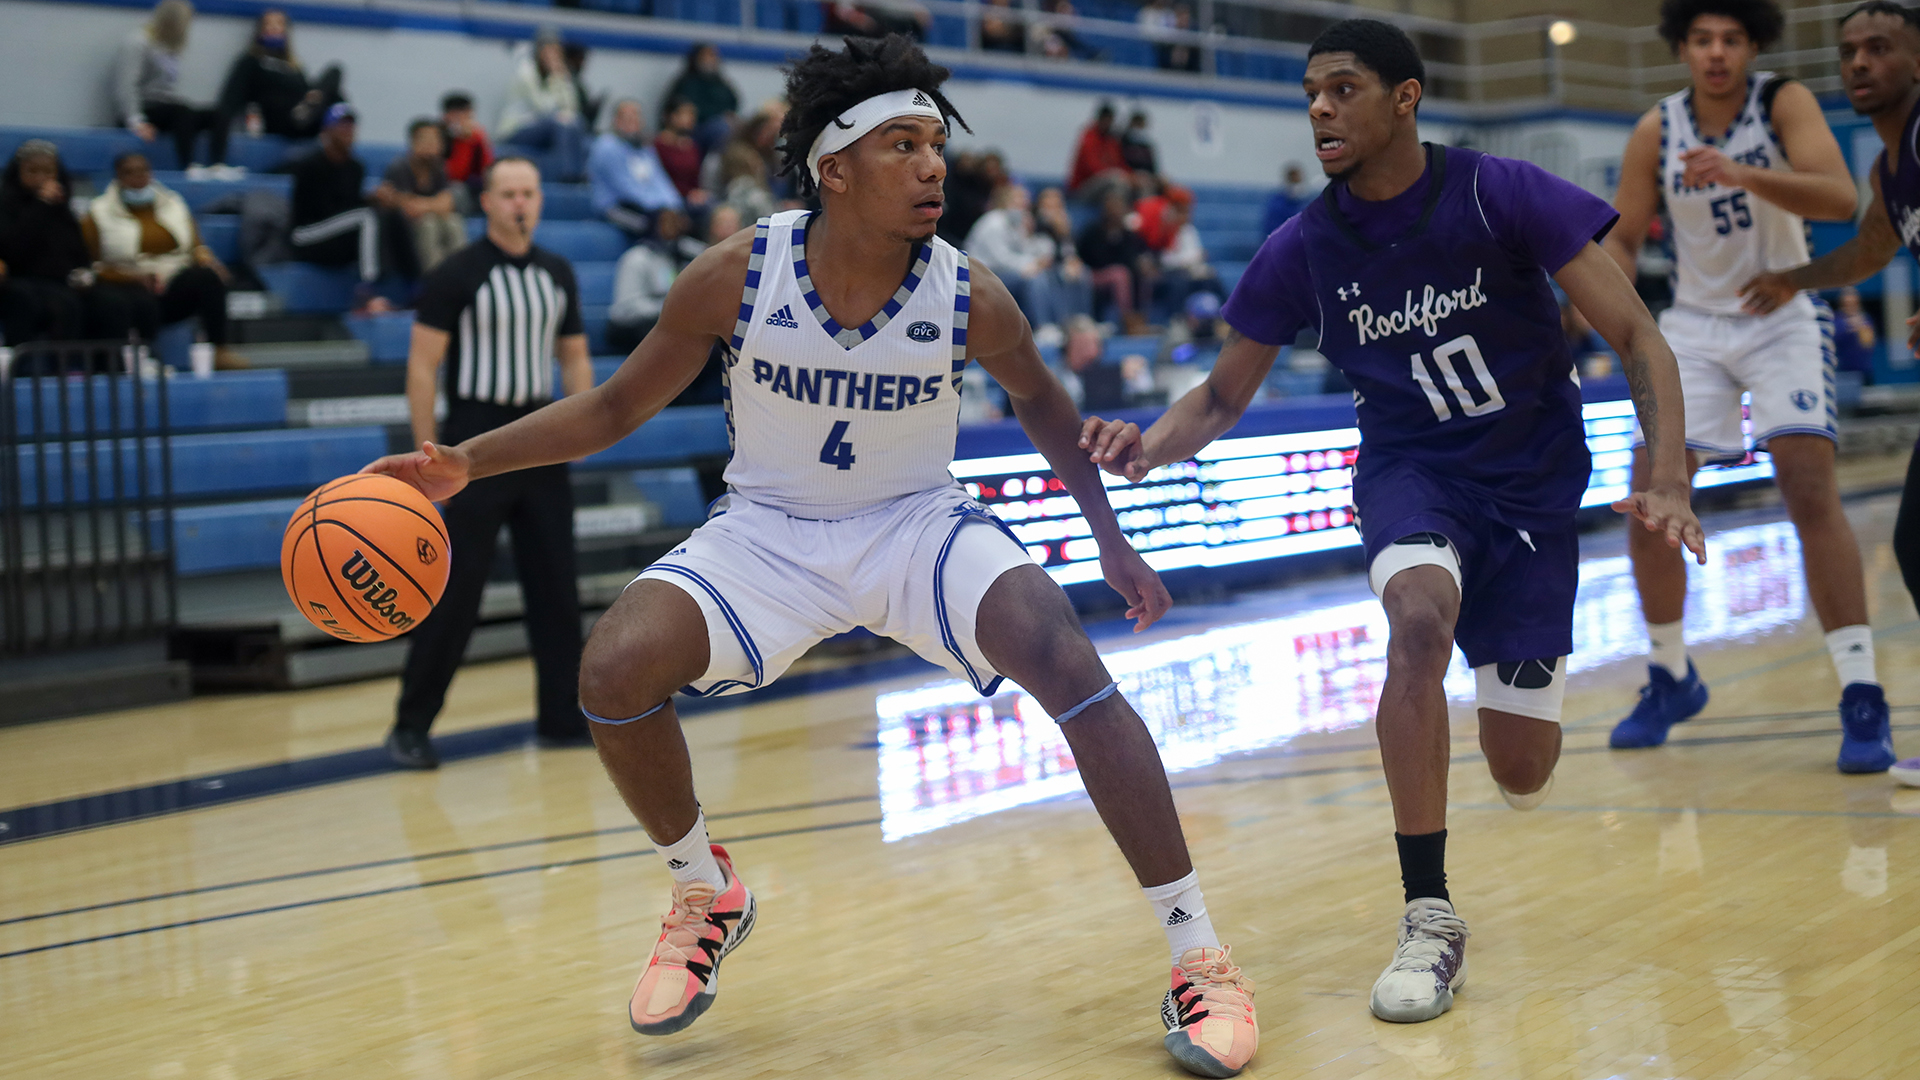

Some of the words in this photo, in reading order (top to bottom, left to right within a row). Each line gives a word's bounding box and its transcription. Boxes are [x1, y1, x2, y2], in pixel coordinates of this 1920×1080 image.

[912, 100, 933, 109] adidas
[1709, 190, 1753, 235] 55
[766, 316, 798, 329] adidas
[1348, 267, 1487, 345] Rockford
[913, 327, 933, 337] OVC
[751, 357, 944, 412] PANTHERS
[1410, 334, 1506, 422] 10
[819, 420, 856, 471] 4
[341, 549, 416, 631] Wilson
[1167, 913, 1193, 926] adidas
